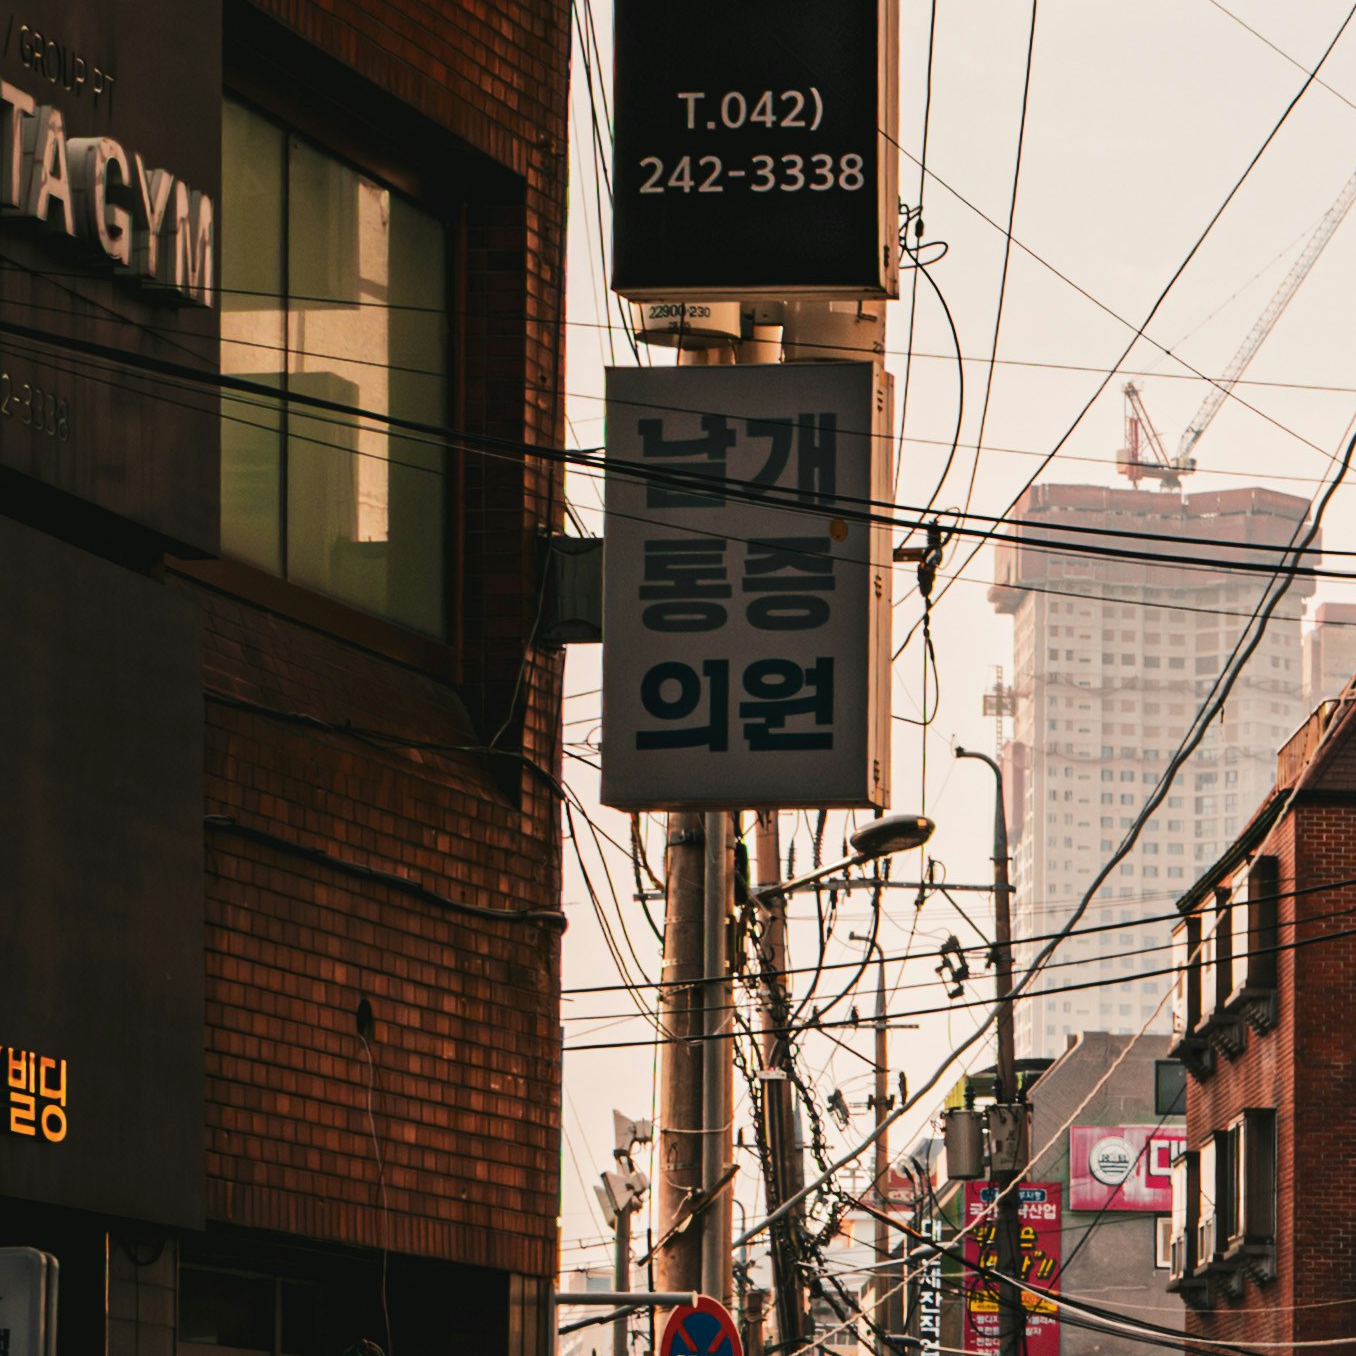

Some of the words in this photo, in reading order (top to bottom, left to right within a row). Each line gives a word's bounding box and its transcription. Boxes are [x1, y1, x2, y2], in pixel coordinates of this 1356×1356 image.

[677, 87, 825, 133] T.042)
[638, 152, 865, 195] 242-3338
[637, 412, 837, 509] 날개
[638, 536, 836, 633] 통증
[635, 656, 835, 752] 의원
[8, 1046, 68, 1143] 빌딩
